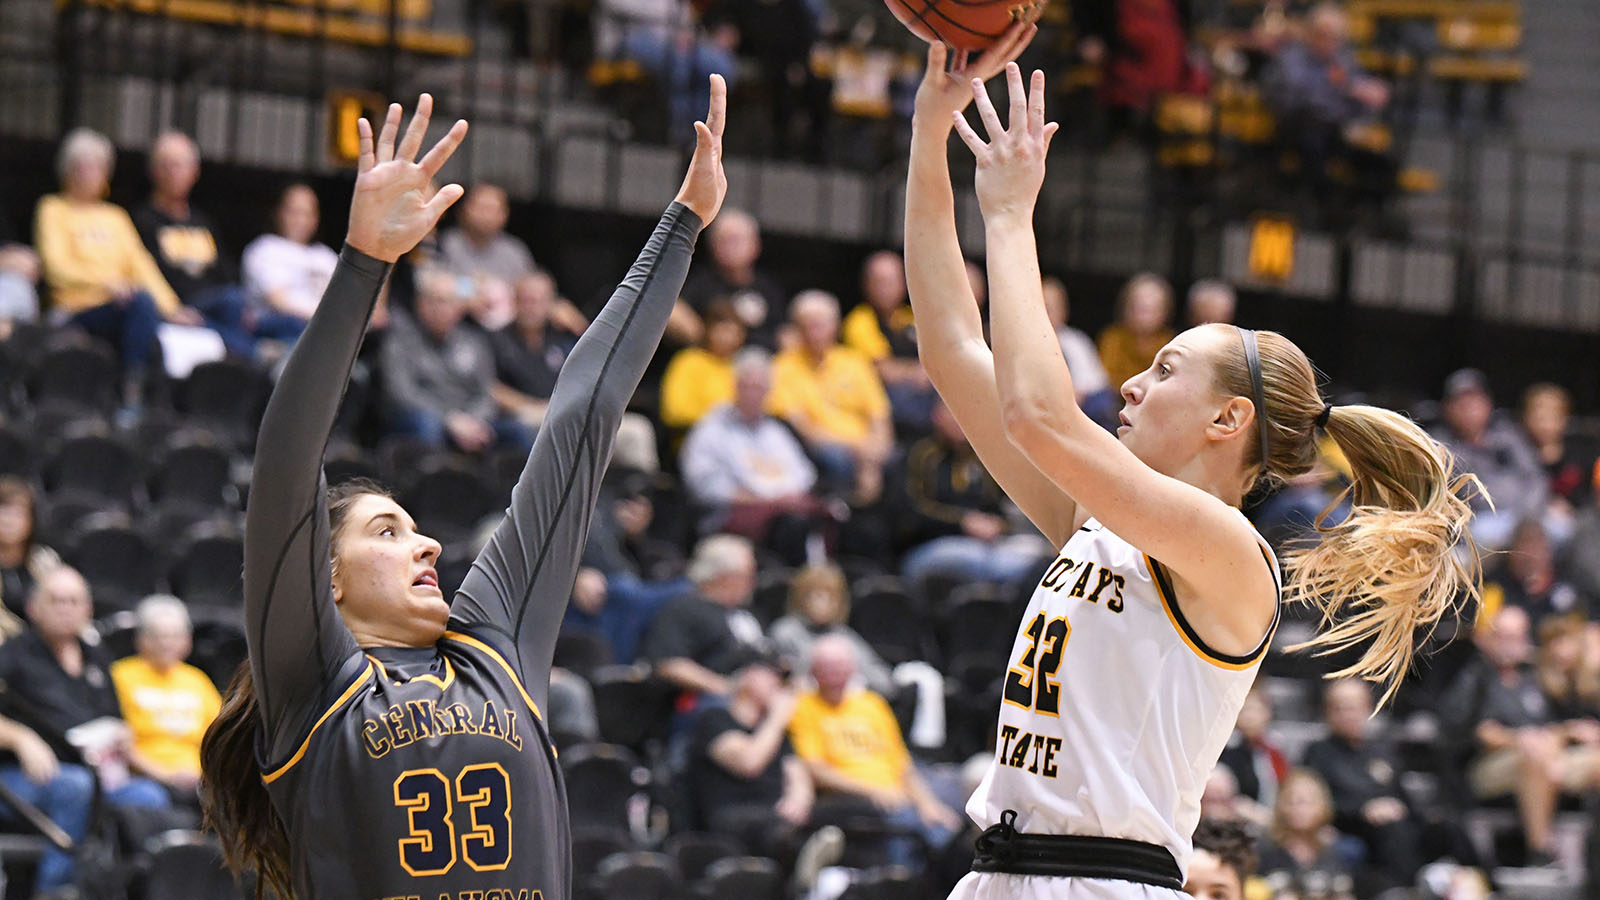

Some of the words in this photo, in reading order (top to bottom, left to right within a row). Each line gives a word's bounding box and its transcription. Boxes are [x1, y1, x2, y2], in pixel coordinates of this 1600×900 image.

[1055, 561, 1126, 613] AYS
[1003, 610, 1072, 718] 32
[1000, 725, 1063, 778] TATE
[393, 762, 512, 877] 33
